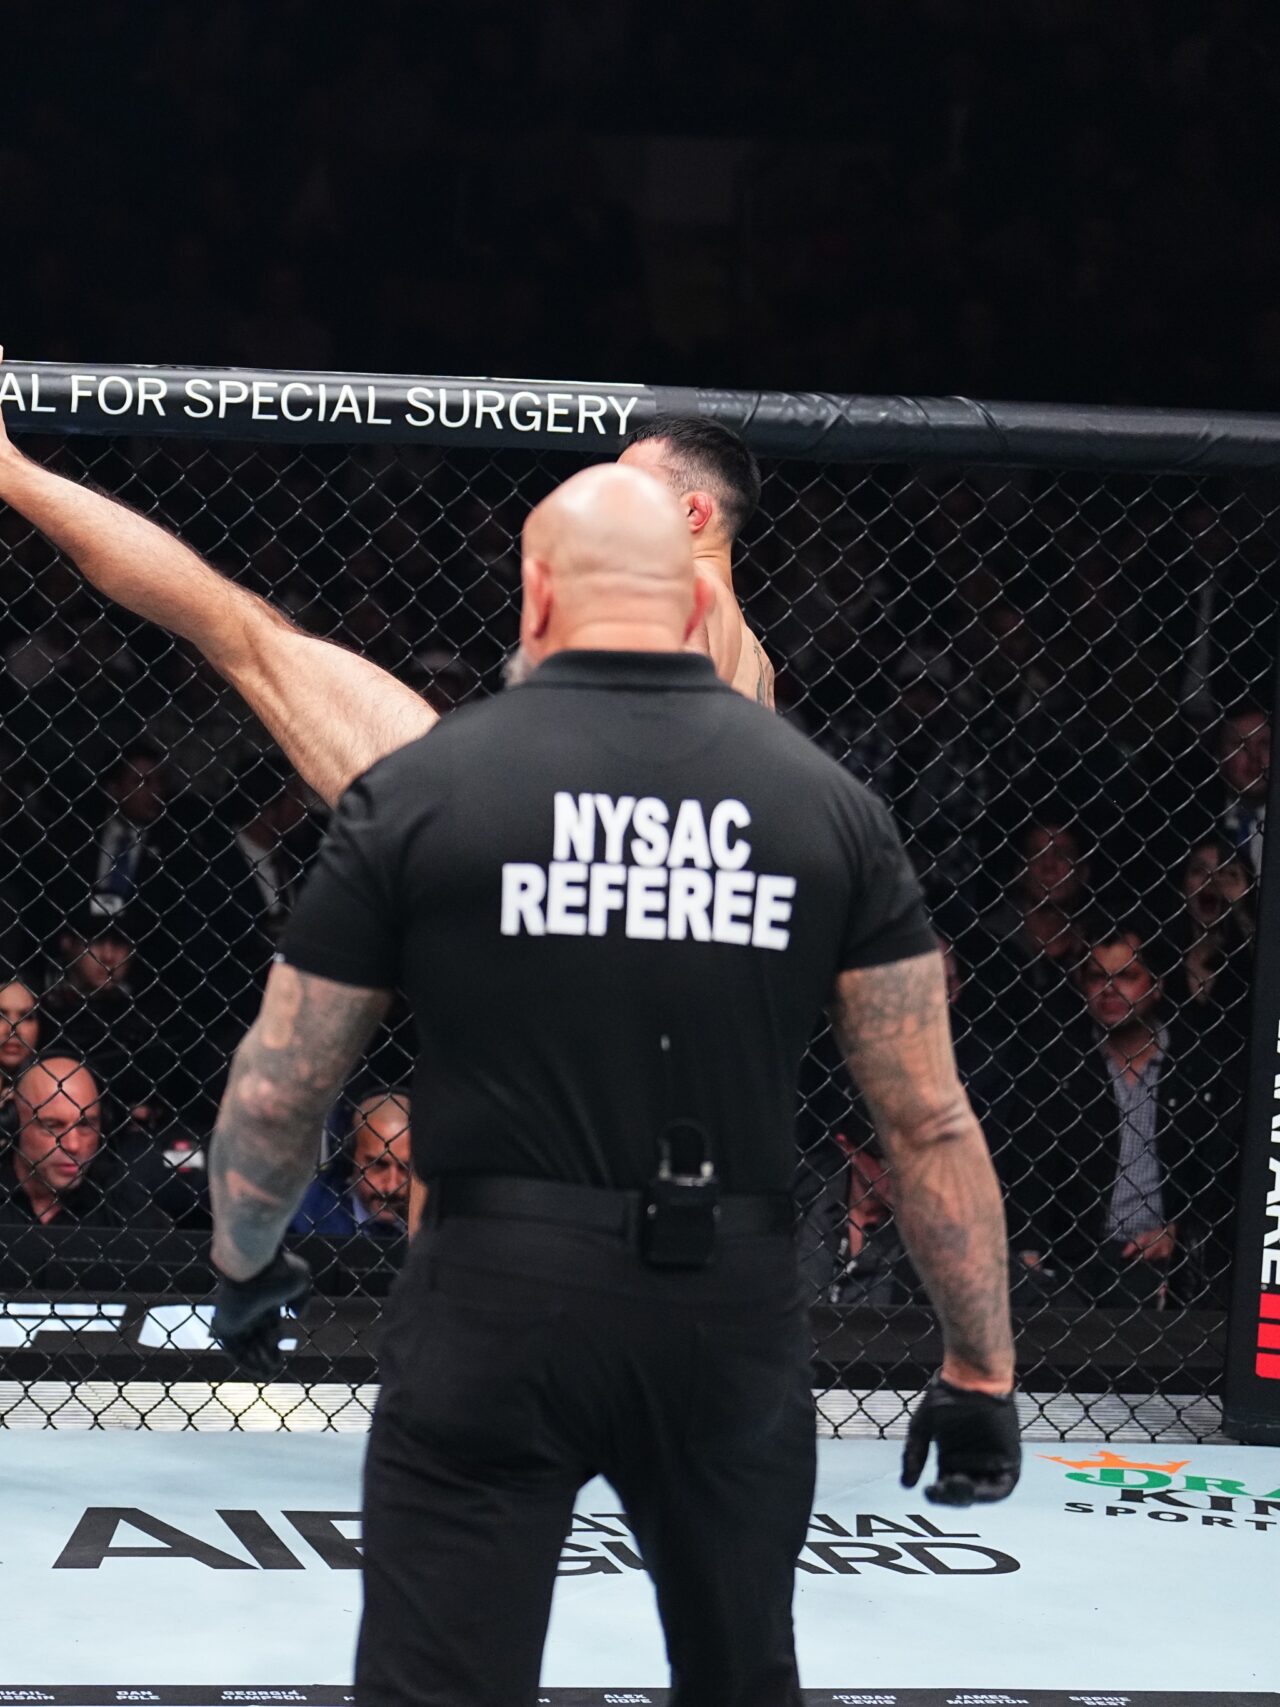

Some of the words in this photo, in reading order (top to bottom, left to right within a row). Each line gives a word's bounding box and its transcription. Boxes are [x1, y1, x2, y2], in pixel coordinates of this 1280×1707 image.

[70, 373, 169, 417] FOR
[183, 378, 392, 426] SPECIAL
[404, 386, 639, 436] SURGERY
[553, 791, 752, 871] NYSAC
[500, 860, 797, 951] REFEREE
